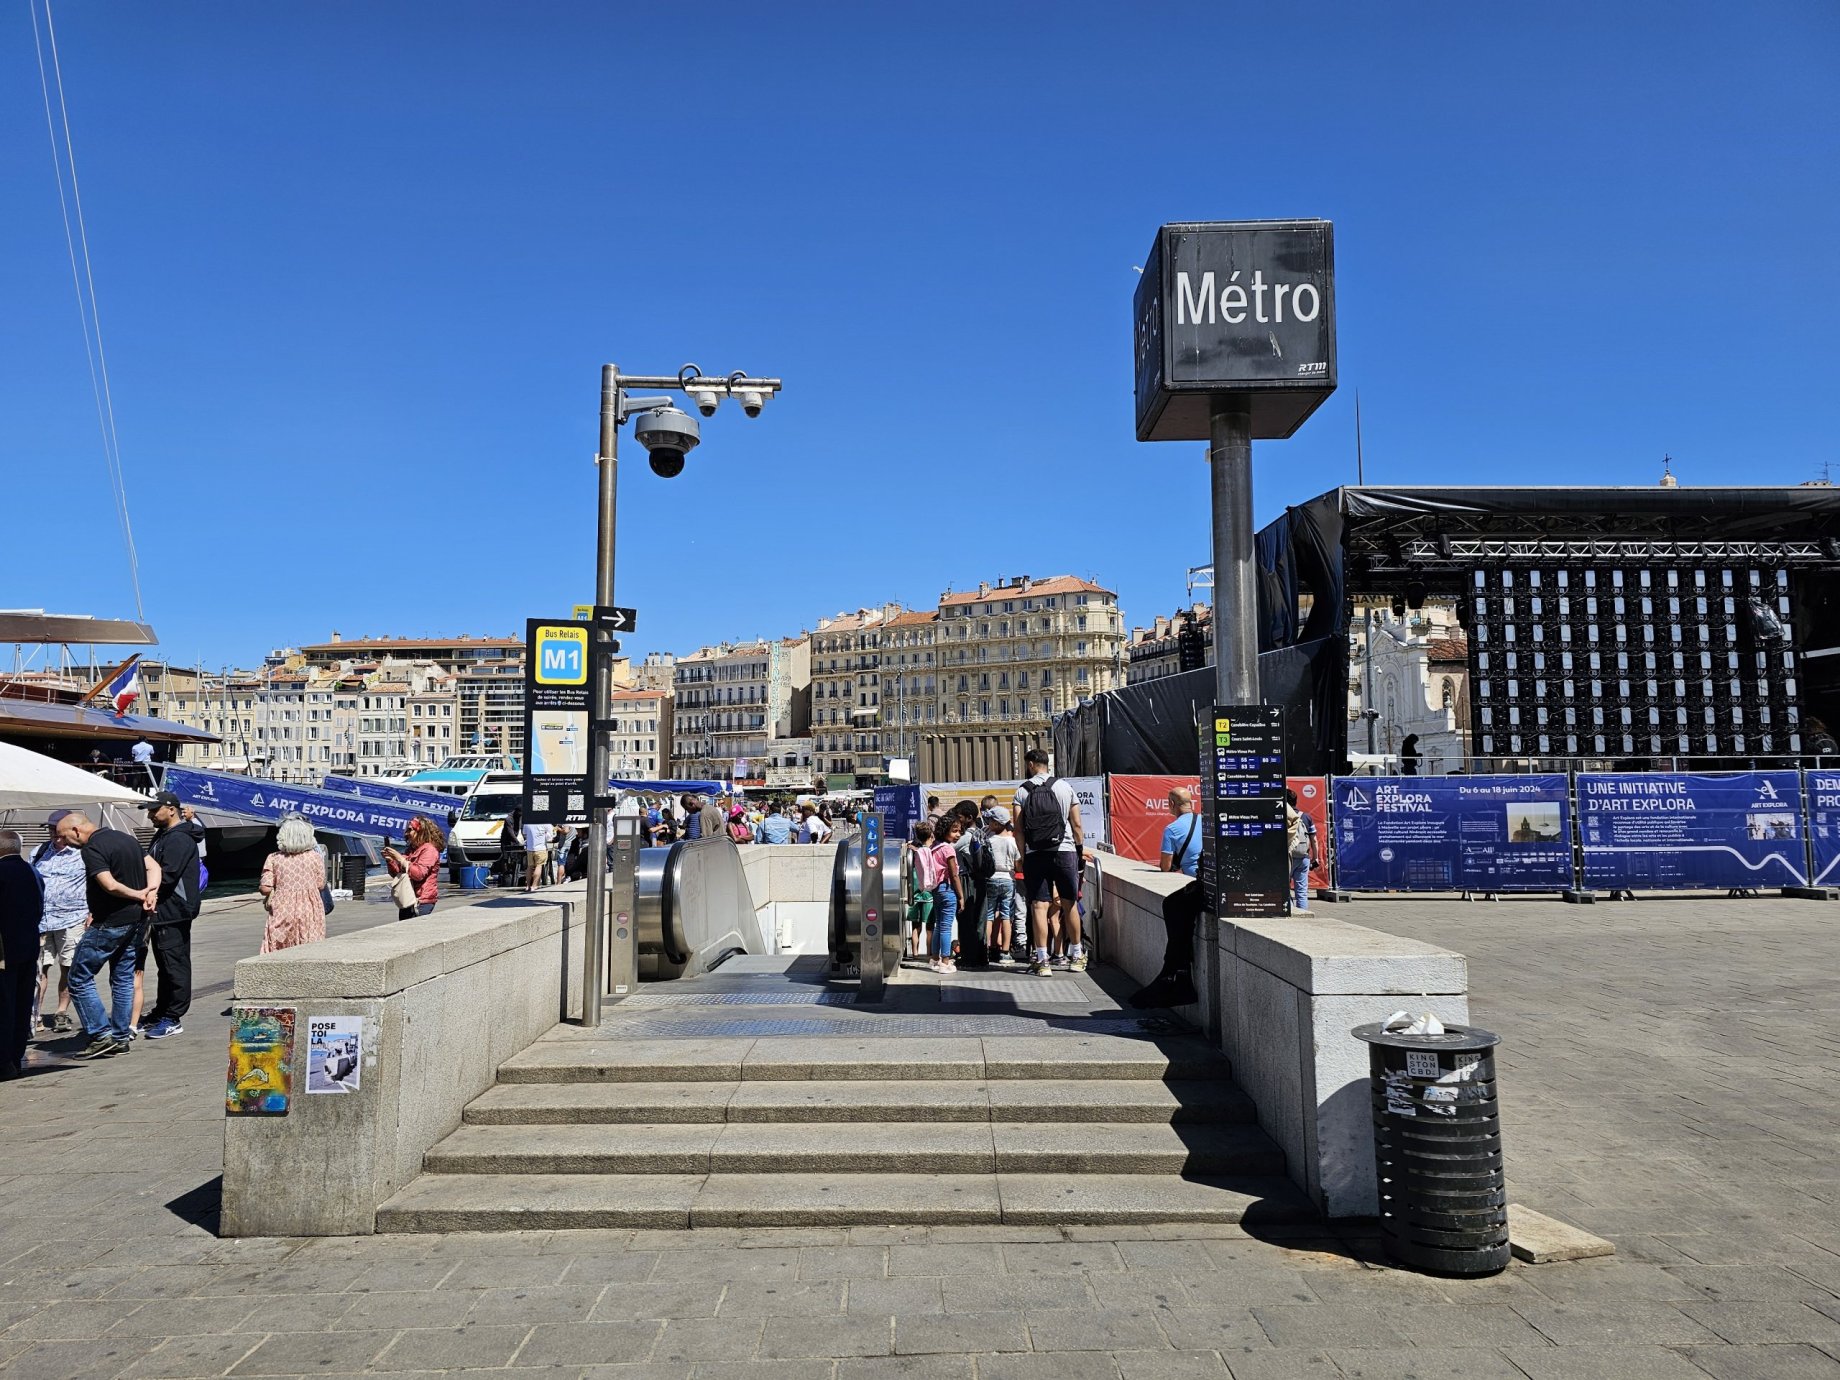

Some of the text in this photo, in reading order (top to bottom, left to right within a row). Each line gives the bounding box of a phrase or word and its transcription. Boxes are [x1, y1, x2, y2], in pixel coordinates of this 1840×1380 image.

[1177, 271, 1320, 324] Métro
[1299, 362, 1327, 371] RTM
[546, 630, 580, 638] Bus Relais
[545, 649, 578, 670] M1
[1376, 785, 1399, 794] ART
[1502, 786, 1518, 794] juin
[1587, 782, 1687, 794] UNE INITIATIVE
[1376, 794, 1432, 803] EXPLORA
[1377, 804, 1432, 812] FESTIVAL
[1588, 799, 1695, 810] D'ART EXPLORA
[269, 798, 408, 830] ART EXPLORA FESTI
